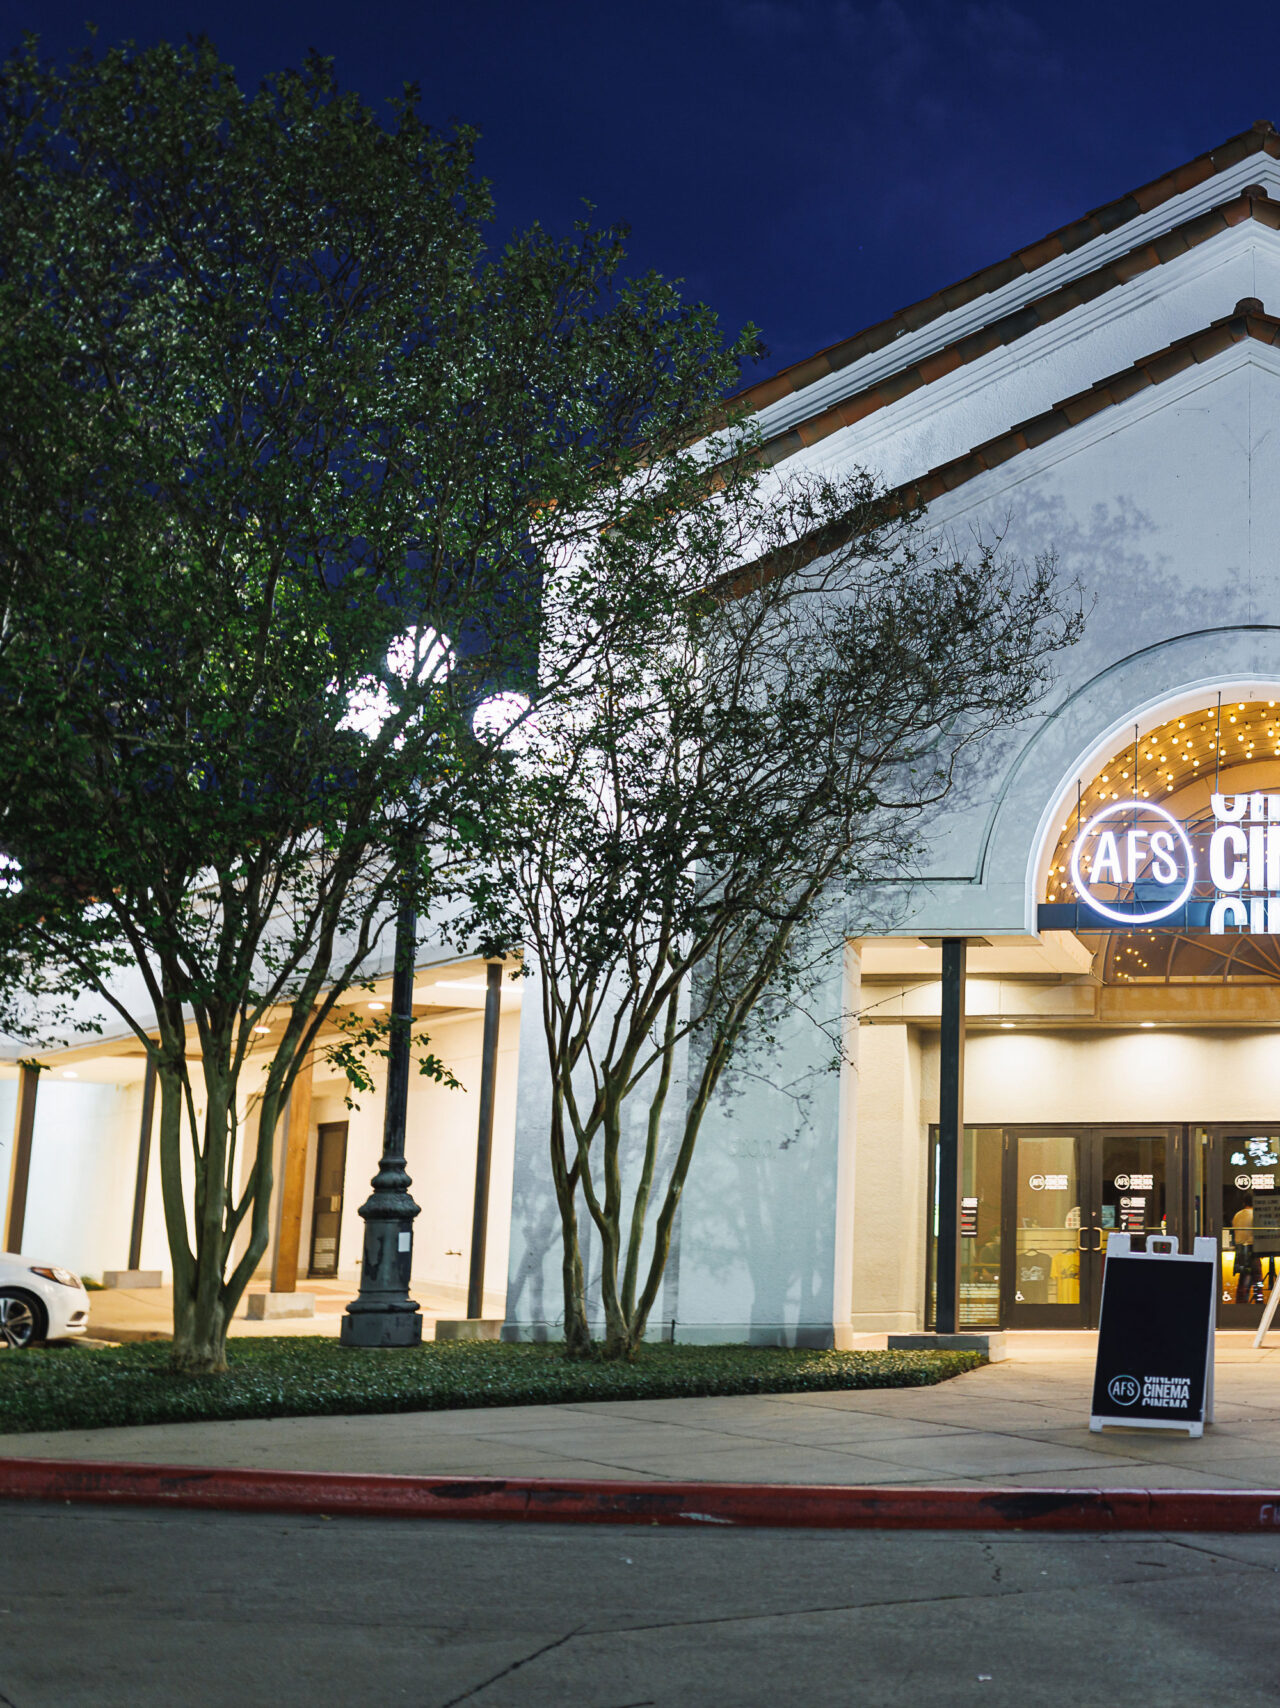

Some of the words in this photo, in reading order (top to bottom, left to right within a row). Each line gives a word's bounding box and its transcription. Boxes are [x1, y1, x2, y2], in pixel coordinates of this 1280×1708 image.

[1089, 830, 1179, 884] AFS
[1112, 1381, 1135, 1397] AFS
[1143, 1383, 1190, 1400] CINEMA
